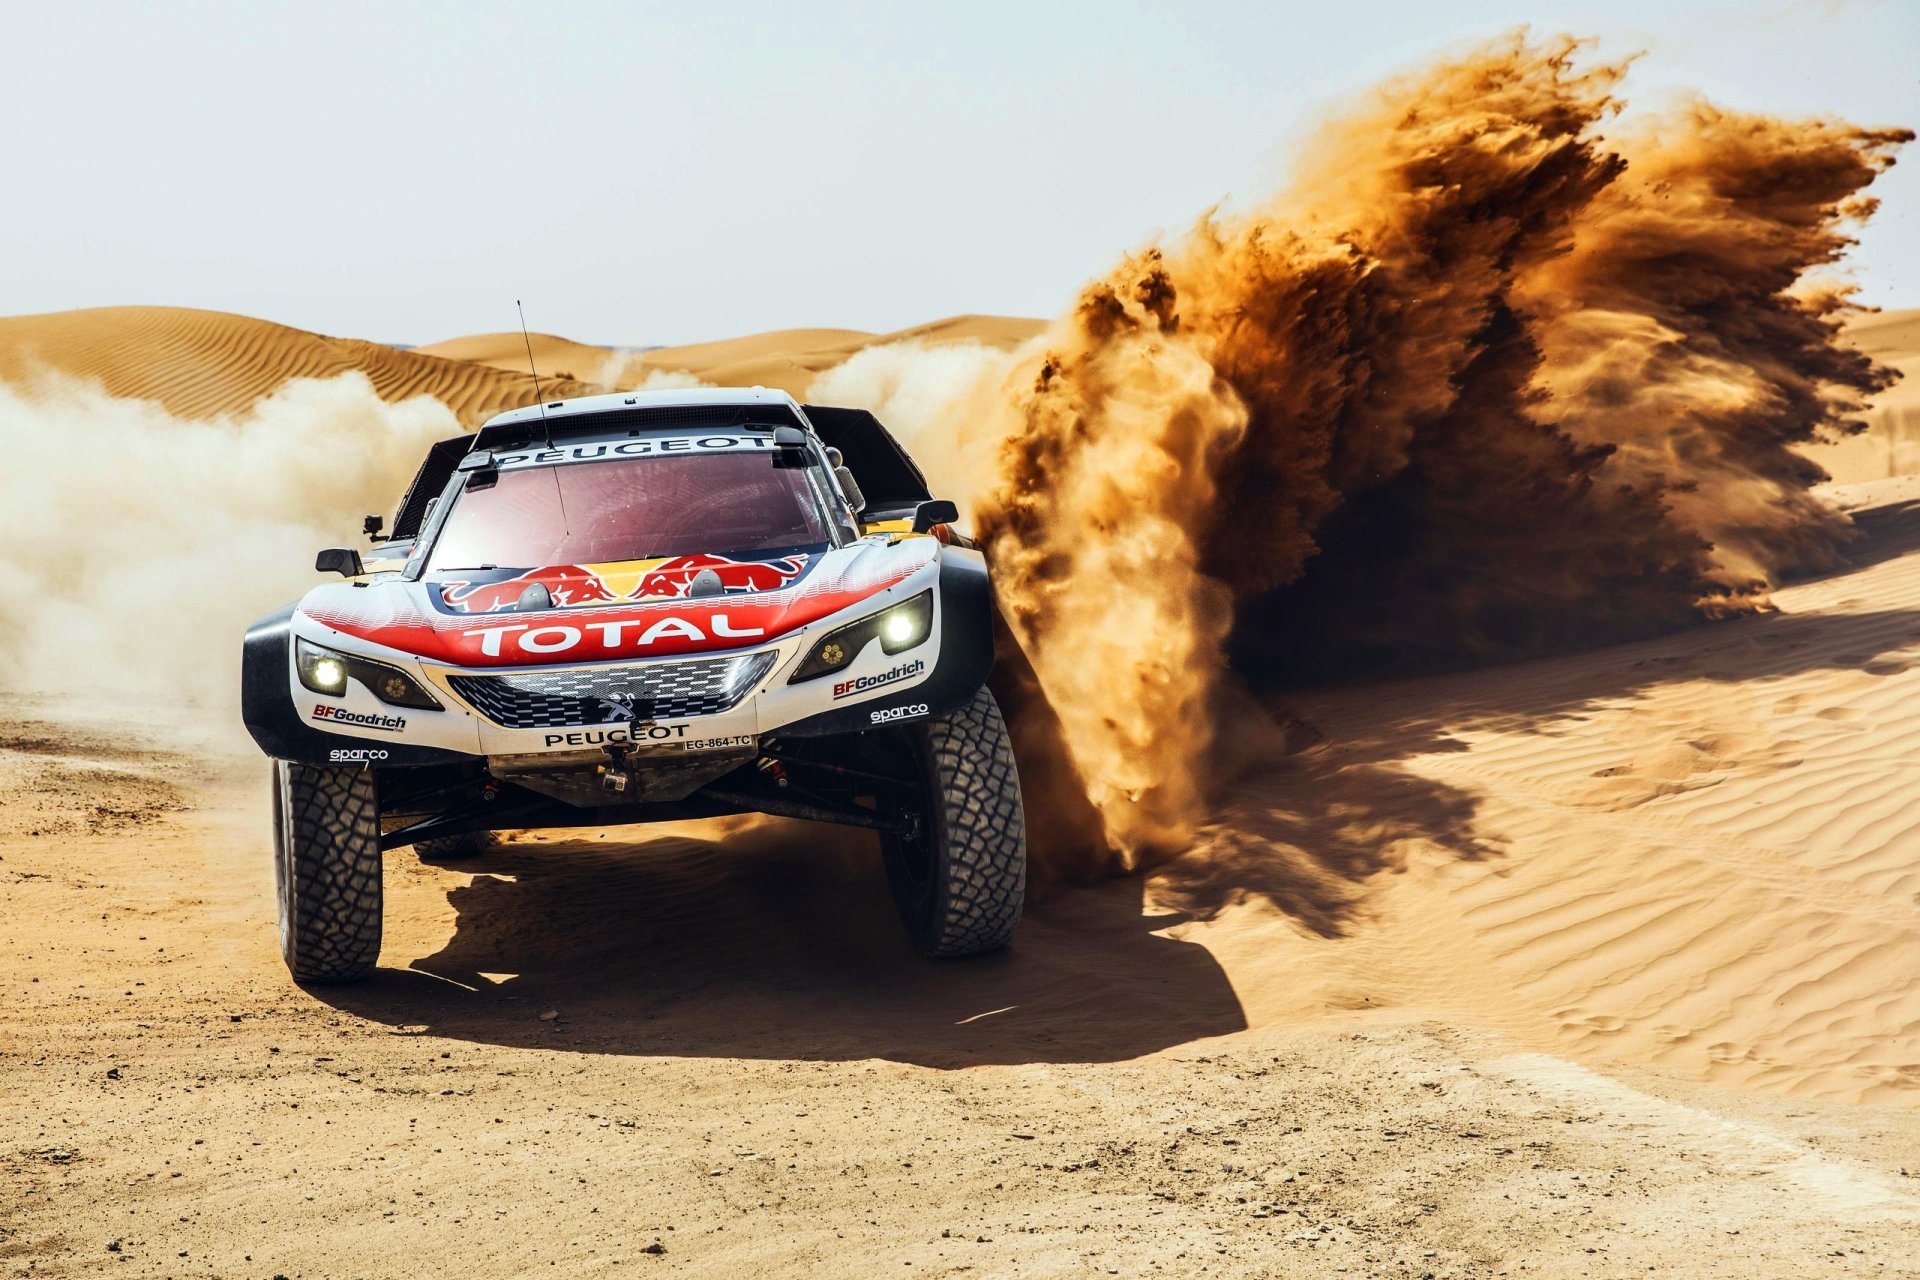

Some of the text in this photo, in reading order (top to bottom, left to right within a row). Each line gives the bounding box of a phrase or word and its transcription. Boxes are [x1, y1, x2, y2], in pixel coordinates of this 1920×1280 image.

[497, 437, 773, 468] PEUGEOT
[463, 614, 764, 657] TOTAL
[833, 660, 924, 697] BFGoodrich
[313, 704, 406, 729] BFGoodrich
[870, 703, 929, 723] sparco
[545, 724, 690, 747] PEUGEOT
[686, 735, 750, 750] EG-864-TC
[329, 749, 389, 763] sparco
